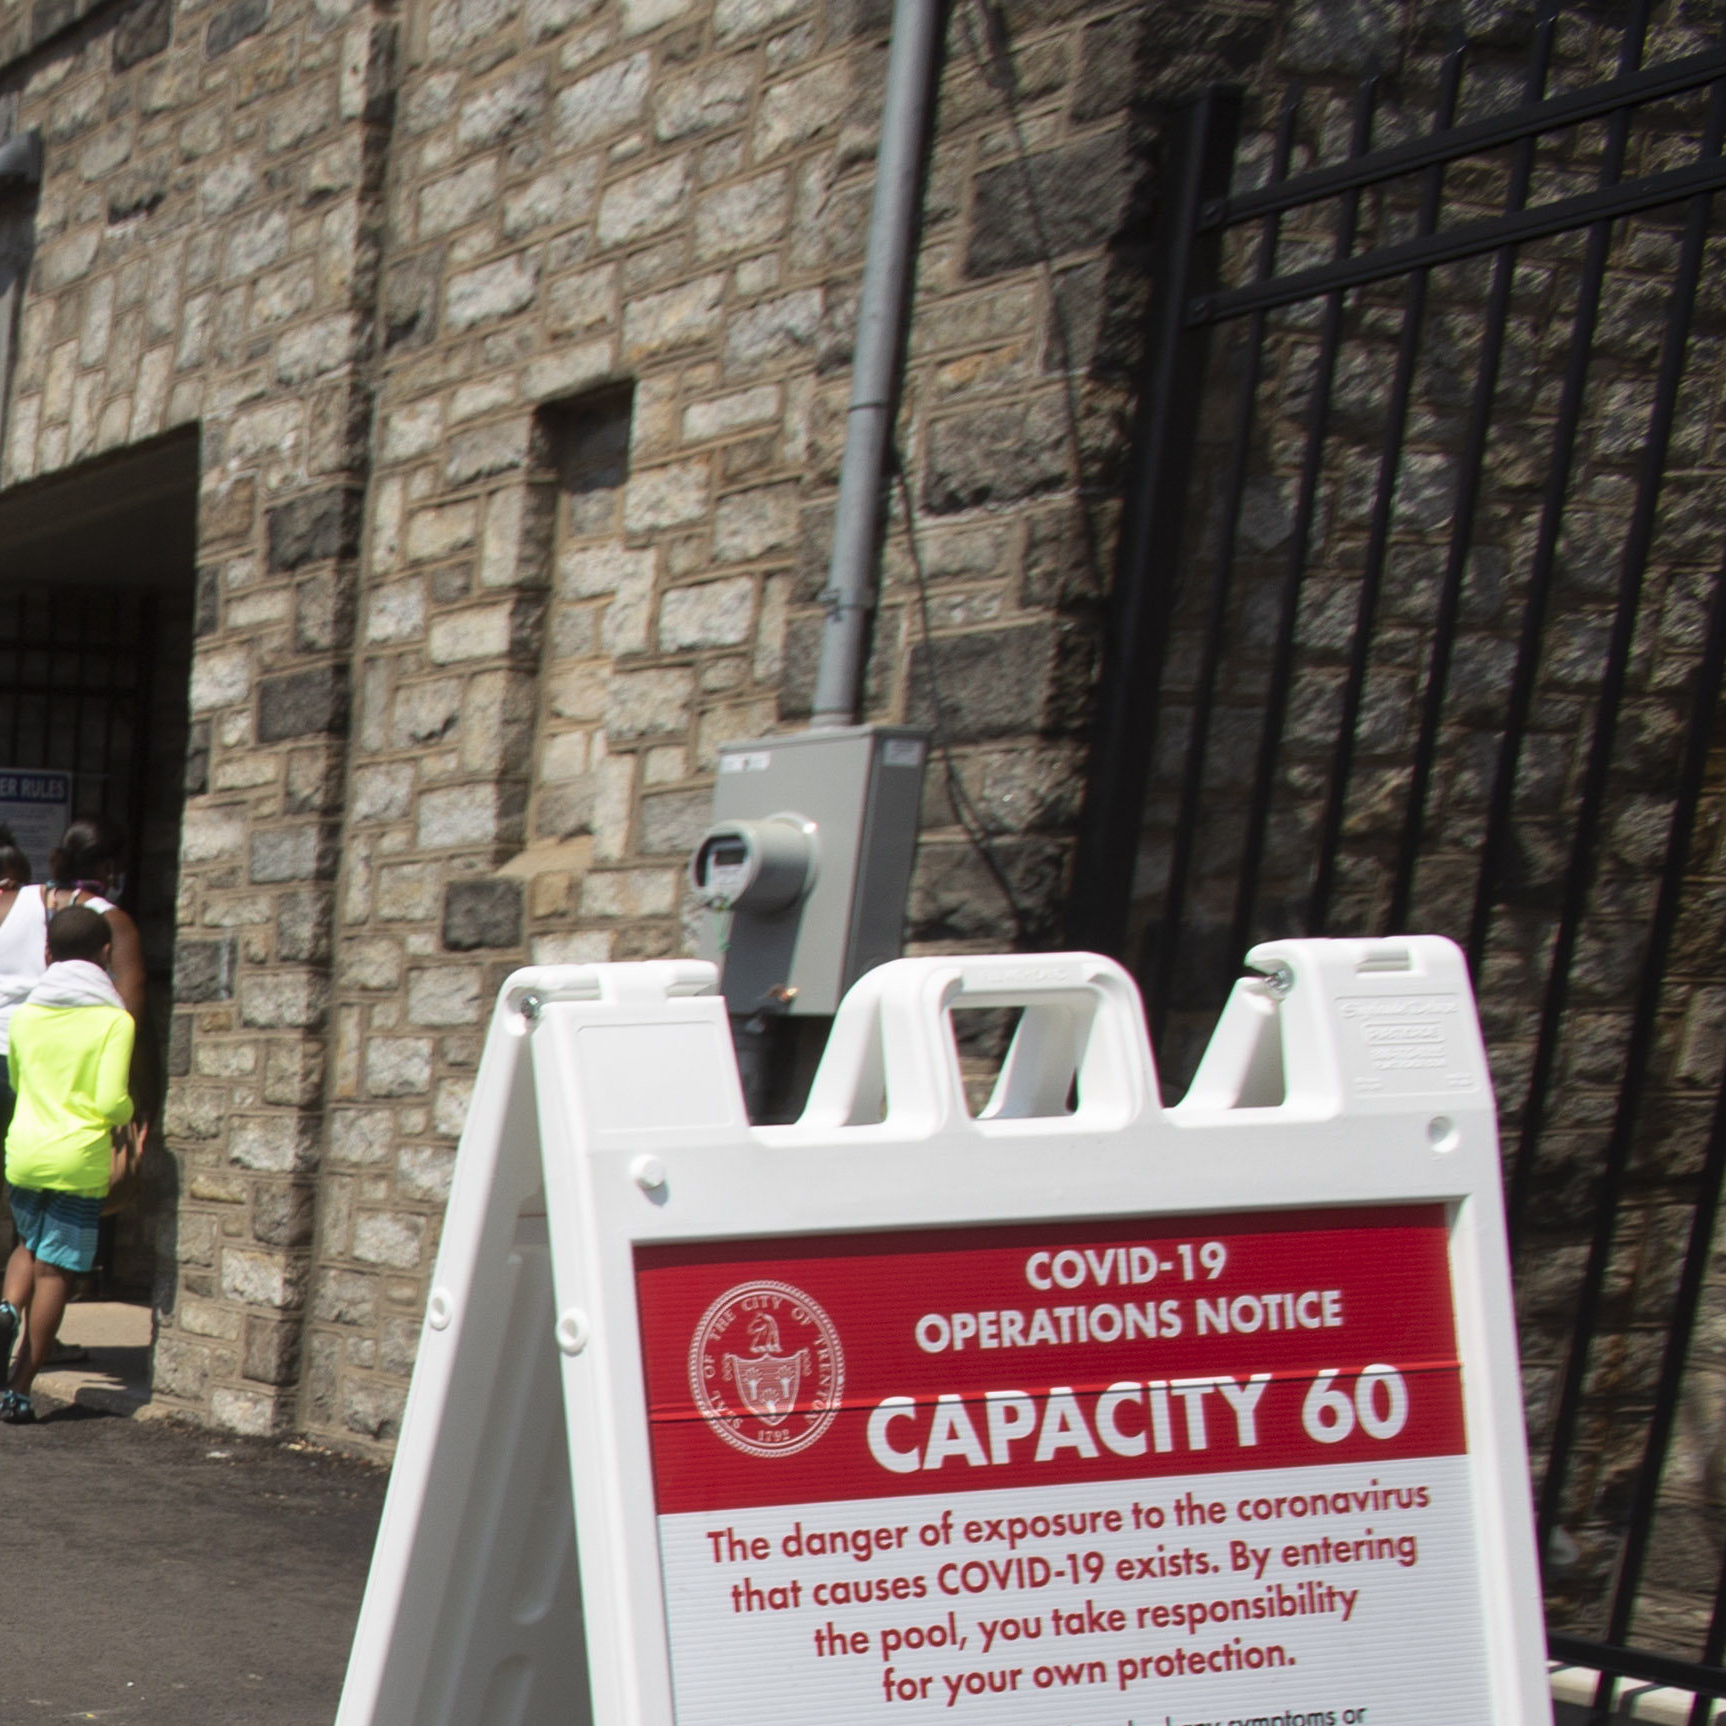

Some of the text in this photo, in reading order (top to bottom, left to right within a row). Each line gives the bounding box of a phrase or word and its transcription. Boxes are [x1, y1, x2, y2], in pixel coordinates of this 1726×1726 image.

[21, 779, 65, 798] RULES
[1026, 1242, 1226, 1289] COVID-19
[916, 1291, 1341, 1352] OPERATIONS NOTICE
[704, 1295, 832, 1430] SEAL OF THE CITY OF TRENTON
[757, 1429, 791, 1442] 1792
[867, 1364, 1407, 1473] CAPACITY 60
[706, 1479, 1430, 1563] The danger of exposure to the coronavirus
[731, 1528, 1417, 1613] that causes COVID-19 exists. By entering
[814, 1583, 1359, 1659] the pool, you take responsibility
[882, 1637, 1295, 1707] for your own protection.
[1343, 1708, 1367, 1724] or
